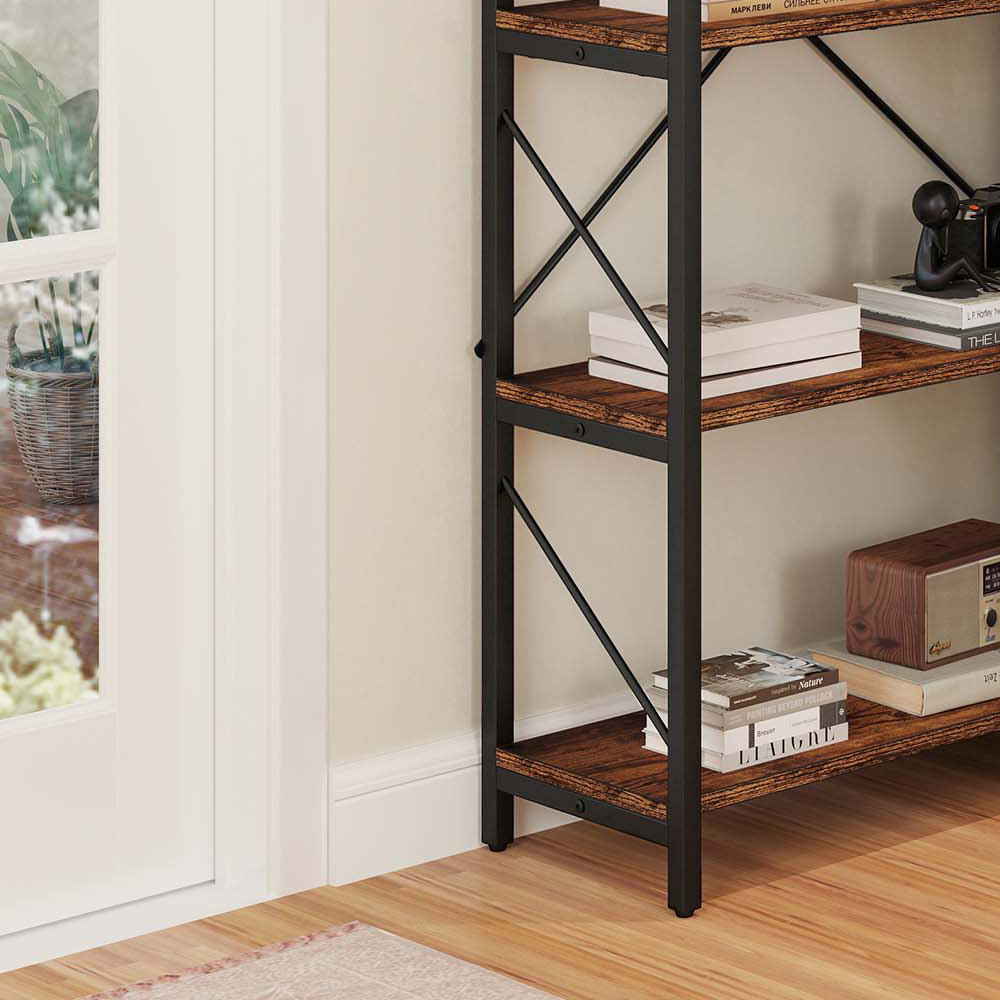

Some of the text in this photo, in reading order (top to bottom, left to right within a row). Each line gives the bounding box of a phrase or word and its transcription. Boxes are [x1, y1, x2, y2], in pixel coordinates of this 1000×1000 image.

[731, 6, 751, 14] МАРК
[751, 3, 772, 12] ЛЕВИ
[968, 333, 992, 348] THE
[984, 672, 998, 682] Zeit
[799, 677, 824, 690] Nature
[756, 728, 776, 737] Brewer
